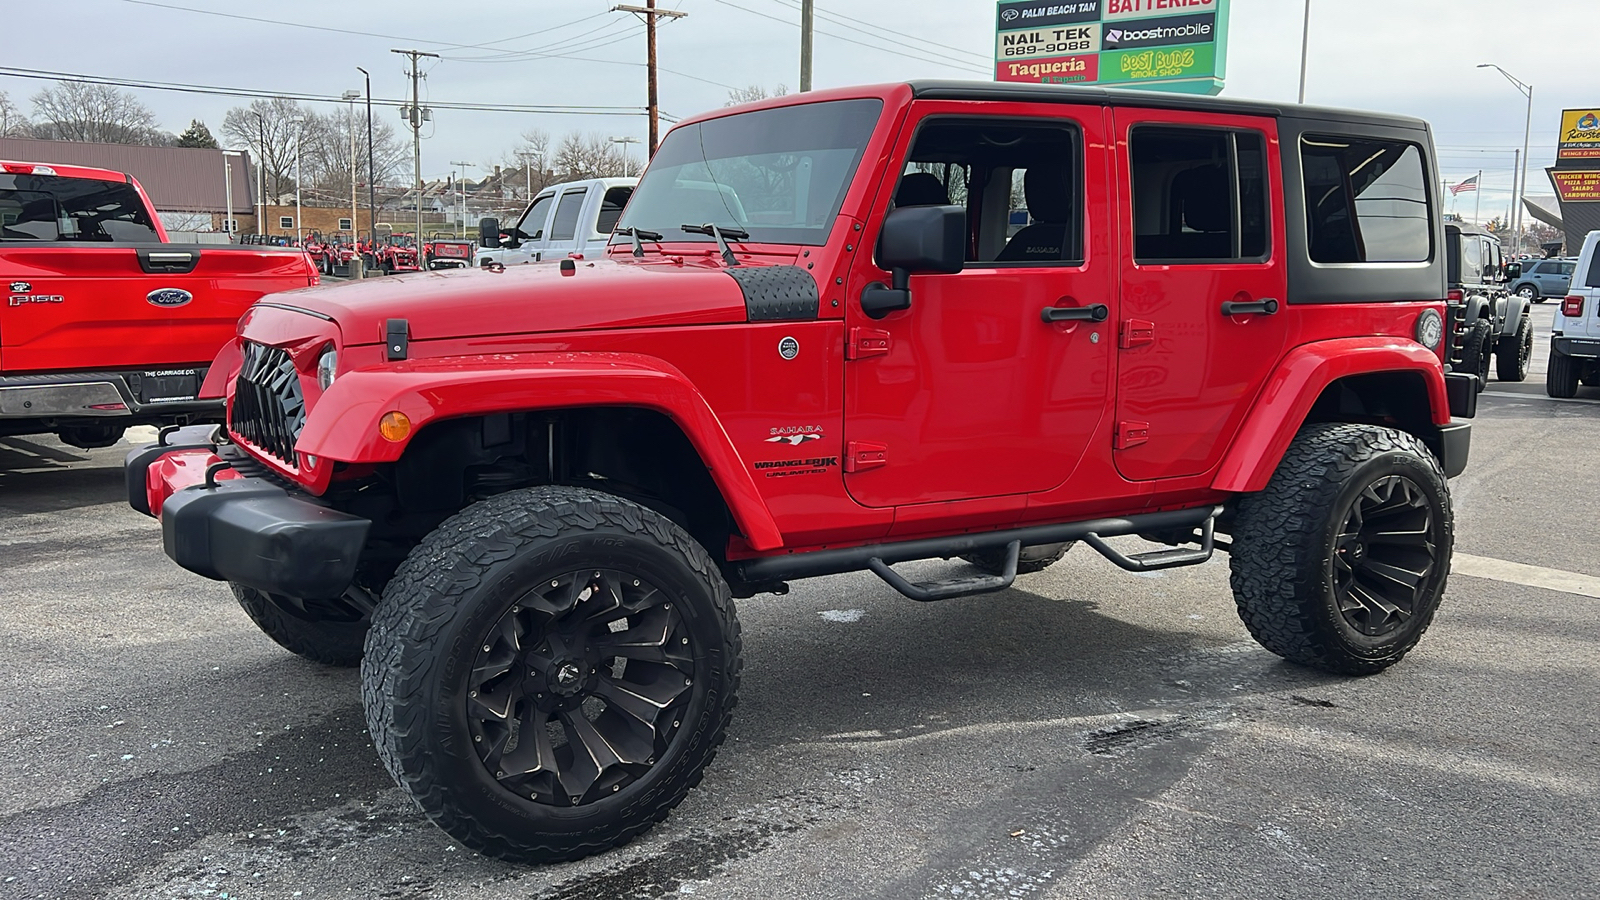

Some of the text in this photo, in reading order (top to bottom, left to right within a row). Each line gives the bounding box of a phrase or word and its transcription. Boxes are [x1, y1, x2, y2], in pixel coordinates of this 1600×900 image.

[1022, 2, 1096, 18] PALM BEACH TAN
[1109, 0, 1212, 14] BATTER
[1004, 27, 1091, 46] NAIL TEK
[1005, 41, 1090, 56] 689-9088
[1159, 68, 1182, 77] SHOP
[158, 291, 183, 303] Ford
[770, 424, 824, 435] SAHARA
[765, 467, 827, 478] UNLIMITED
